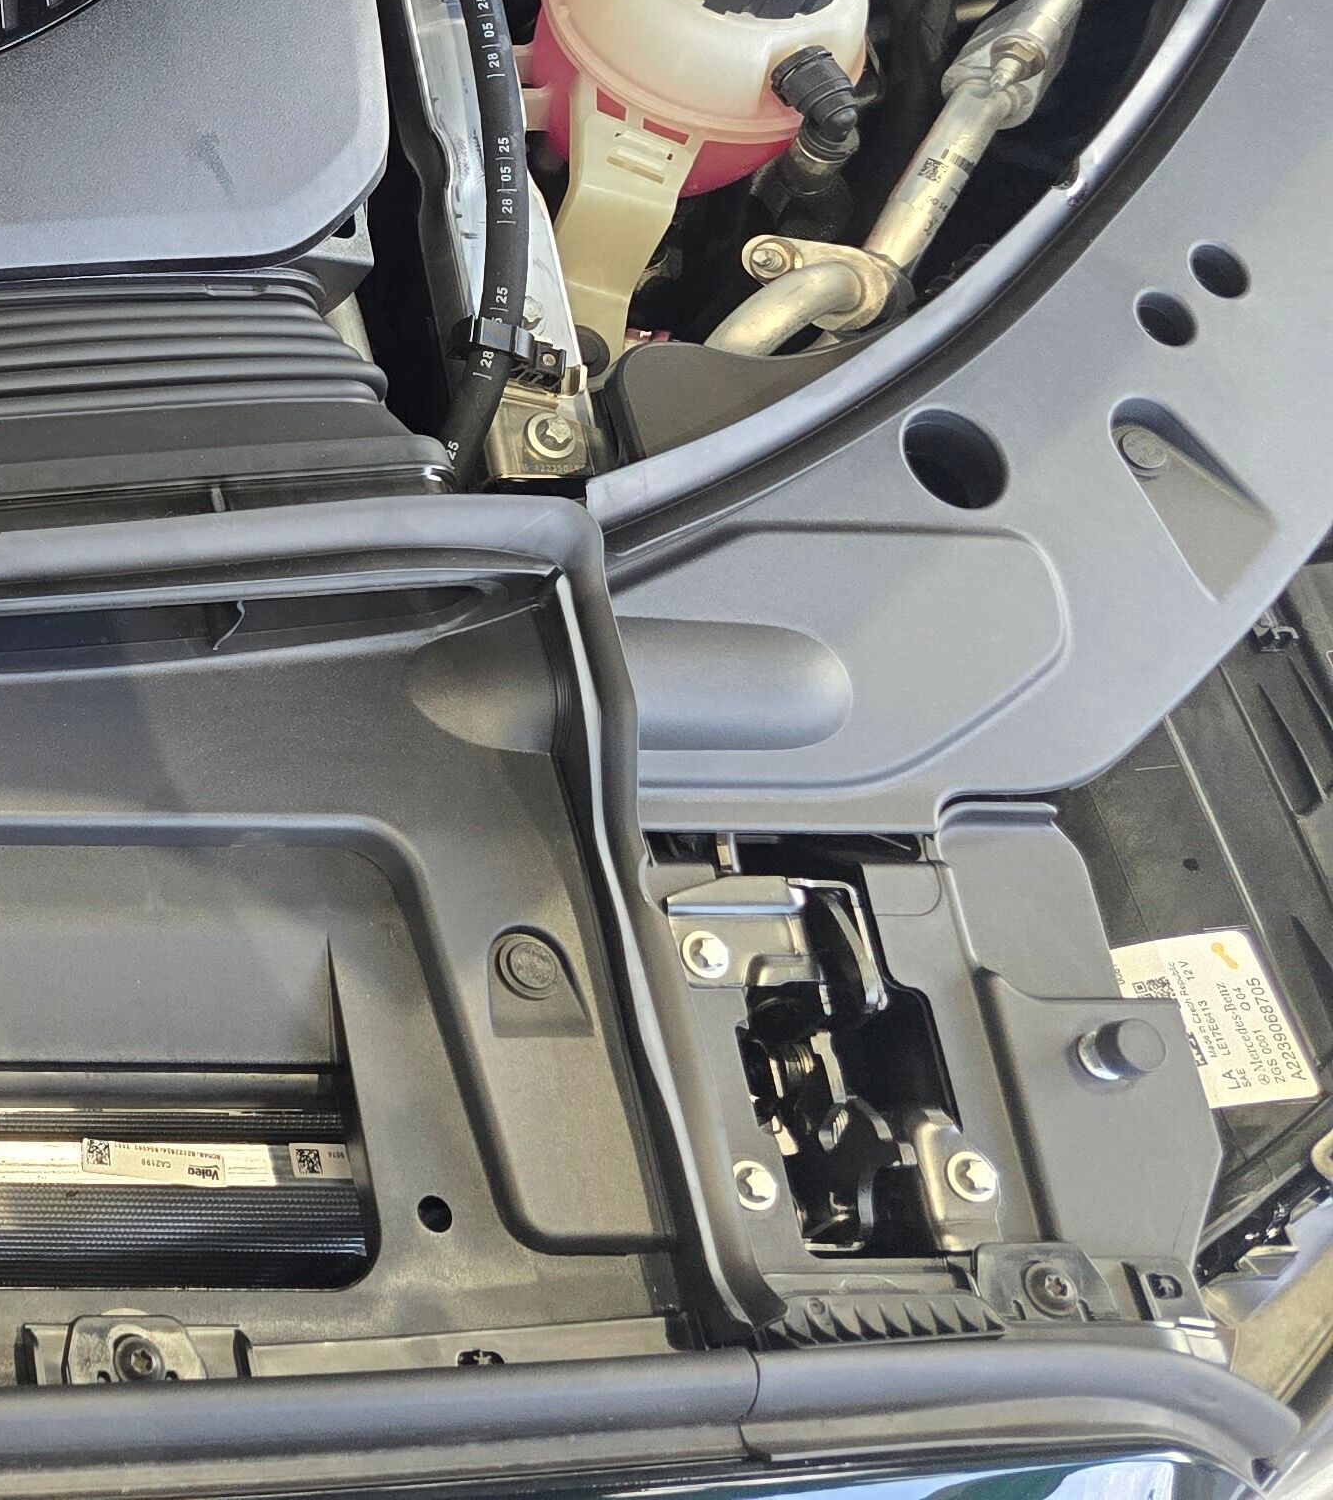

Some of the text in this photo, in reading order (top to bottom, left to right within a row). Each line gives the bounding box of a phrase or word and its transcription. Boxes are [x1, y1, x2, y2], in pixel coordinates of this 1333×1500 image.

[482, 21, 495, 39] 05
[486, 51, 502, 69] 28
[497, 136, 513, 215] 28 05 25
[495, 286, 509, 305] 25
[479, 350, 495, 369] 28
[446, 439, 460, 461] 25
[1215, 981, 1265, 1073] Mercedes-Benz
[1245, 976, 1308, 1081] A2239068705
[1252, 1029, 1273, 1055] 0001
[1221, 1068, 1242, 1090] LA
[1235, 1067, 1252, 1088] SAE
[1265, 1058, 1286, 1085] ZGS
[187, 1165, 220, 1181] Valeo
